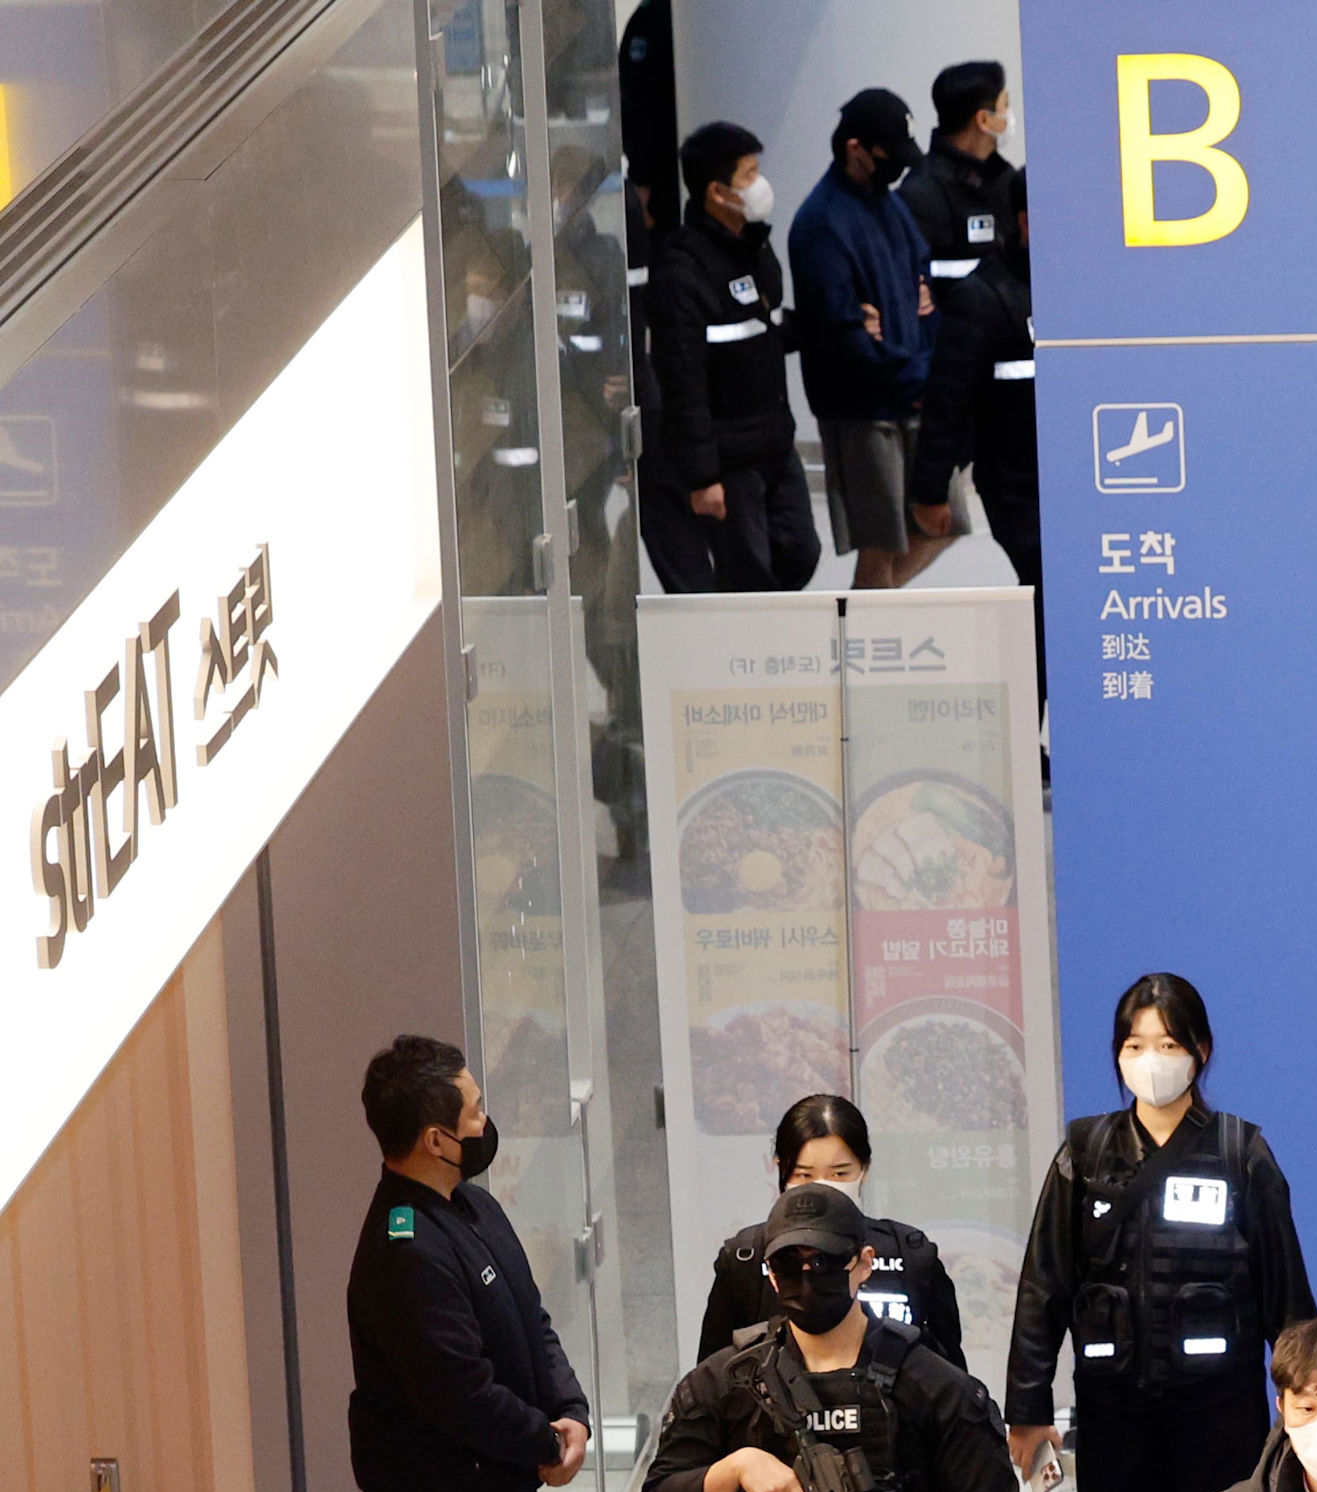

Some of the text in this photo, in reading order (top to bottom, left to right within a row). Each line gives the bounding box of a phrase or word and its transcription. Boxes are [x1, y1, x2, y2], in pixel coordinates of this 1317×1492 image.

[1116, 53, 1249, 248] B
[1099, 531, 1176, 574] 도착
[1101, 587, 1227, 620] Arrivals
[194, 542, 278, 767] 스트릿
[1102, 634, 1150, 662] 到达
[1102, 671, 1154, 700] 到着
